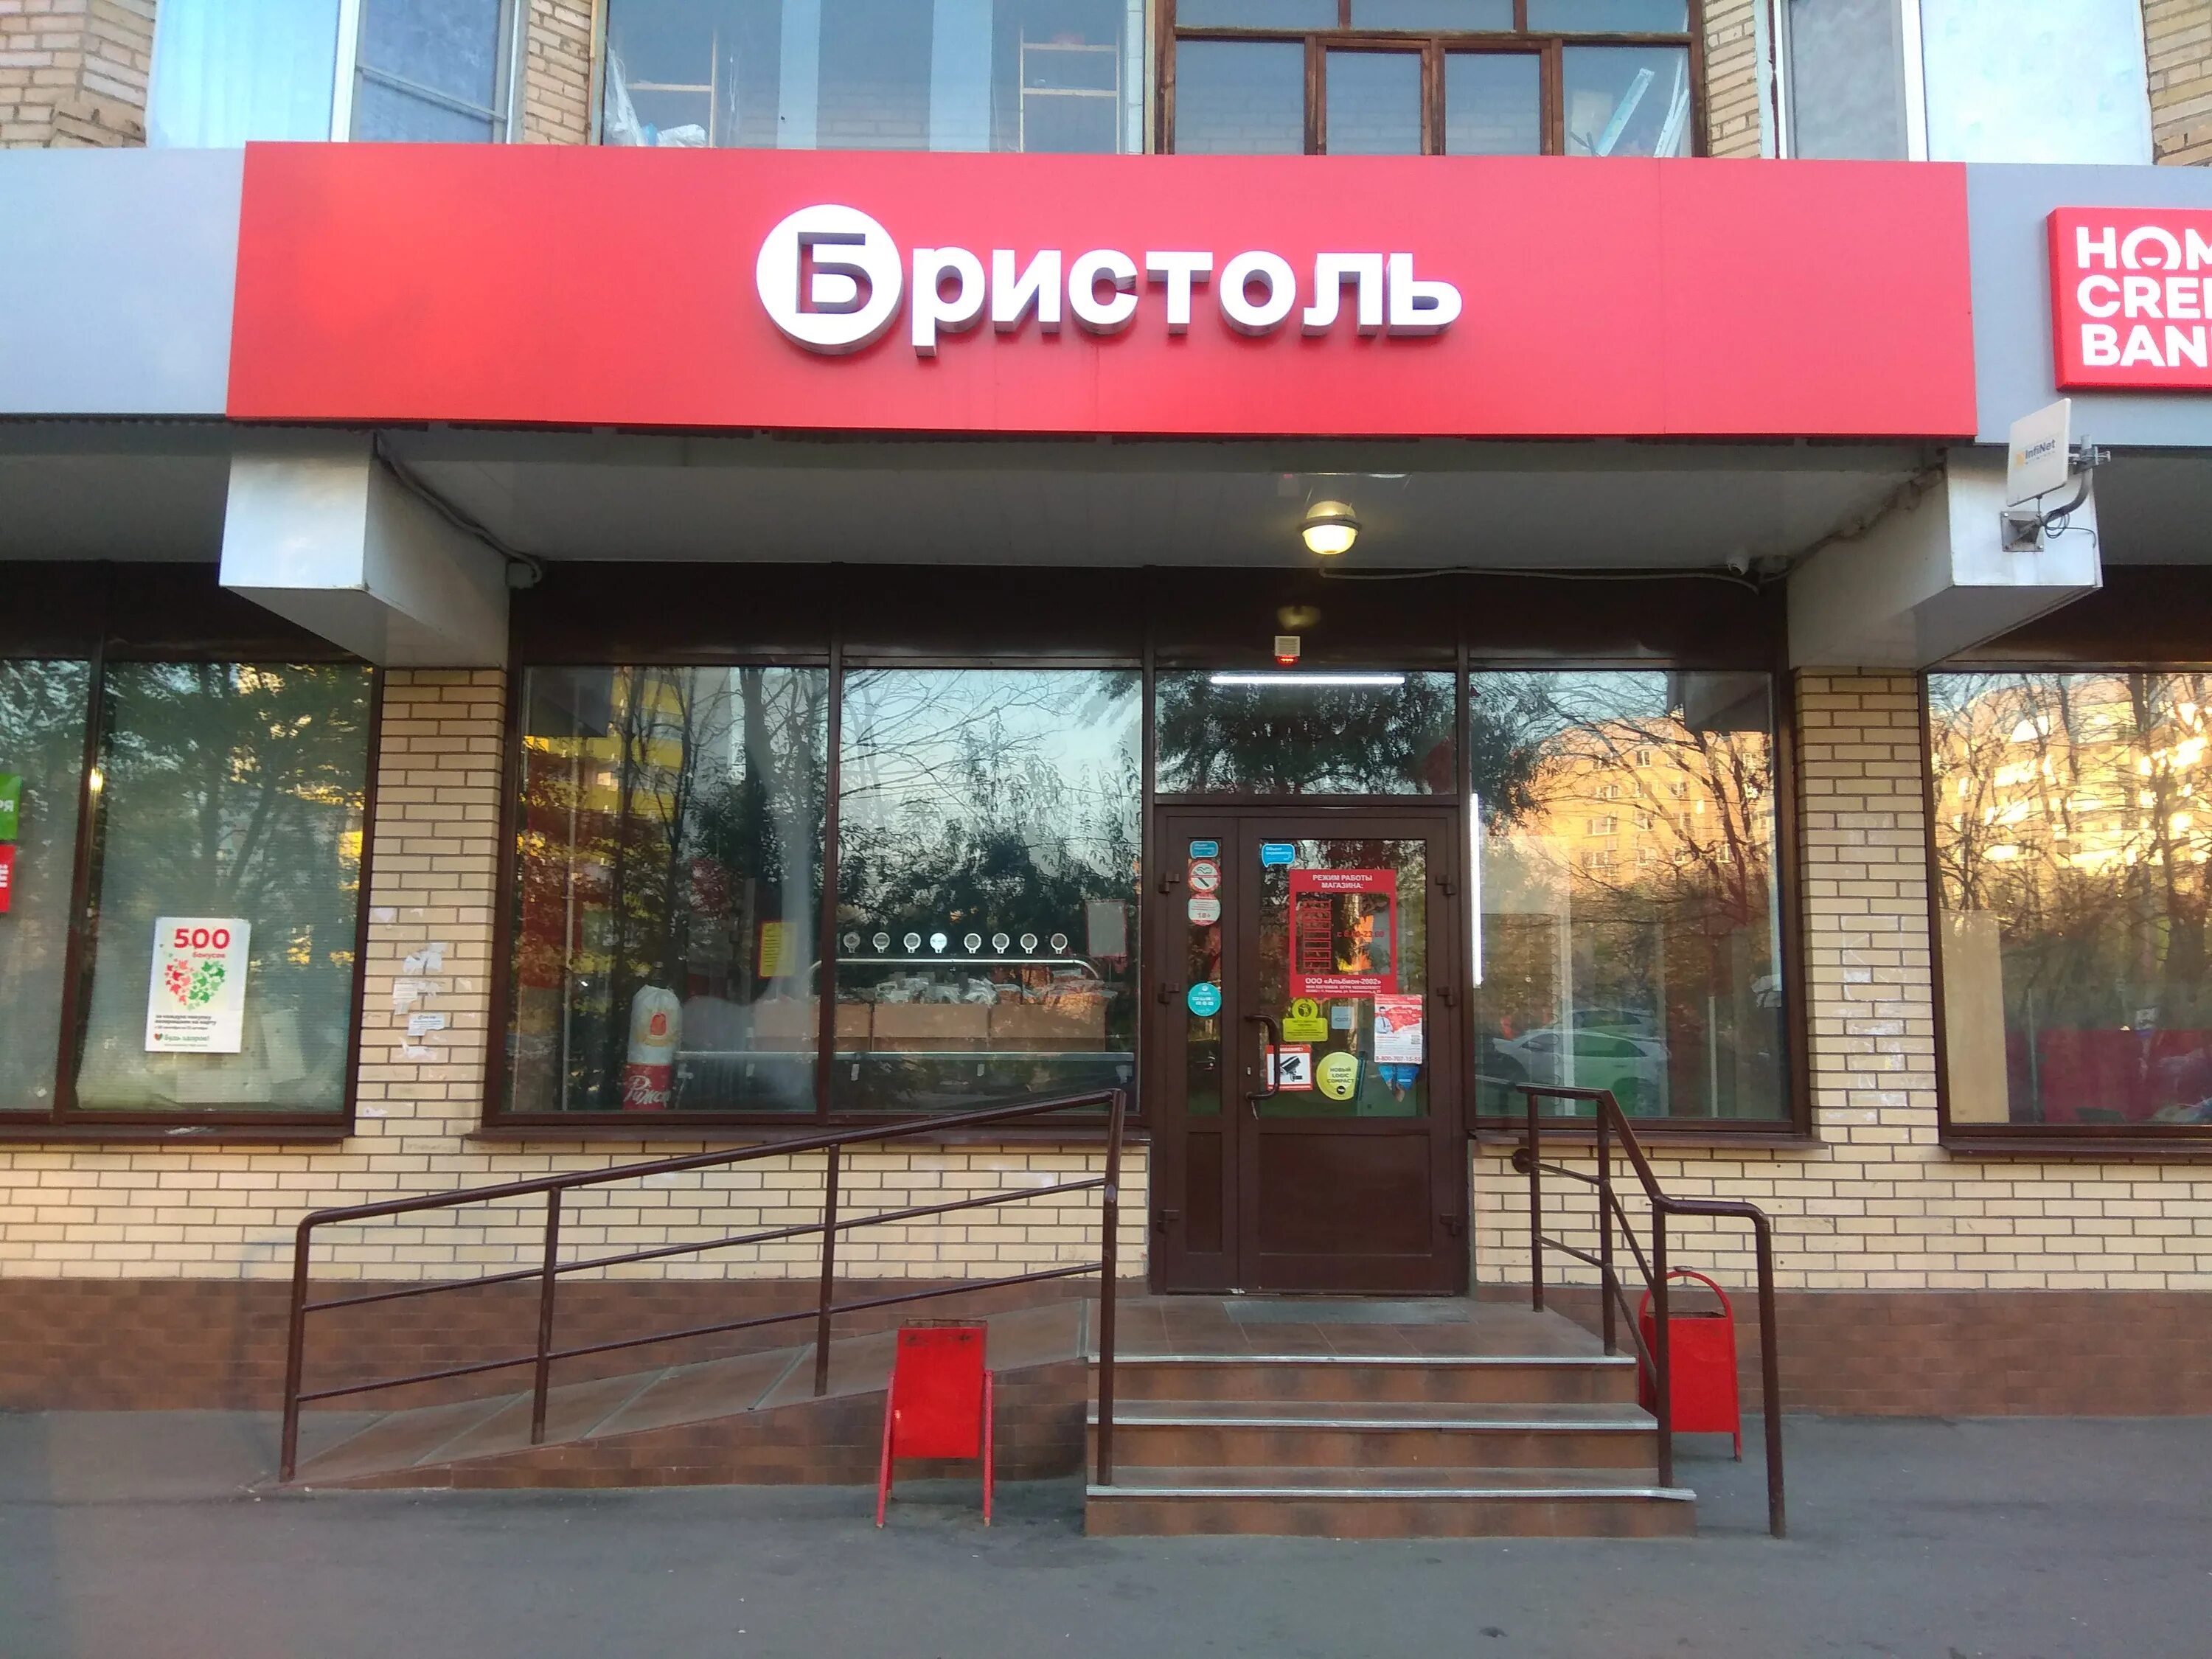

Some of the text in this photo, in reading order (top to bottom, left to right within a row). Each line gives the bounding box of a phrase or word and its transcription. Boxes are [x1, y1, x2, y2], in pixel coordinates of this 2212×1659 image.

[757, 204, 1463, 356] Бристоль
[2076, 274, 2212, 319] CRE
[2081, 323, 2212, 368] BAN
[2025, 439, 2056, 459] InfiNet
[174, 928, 230, 950] 500
